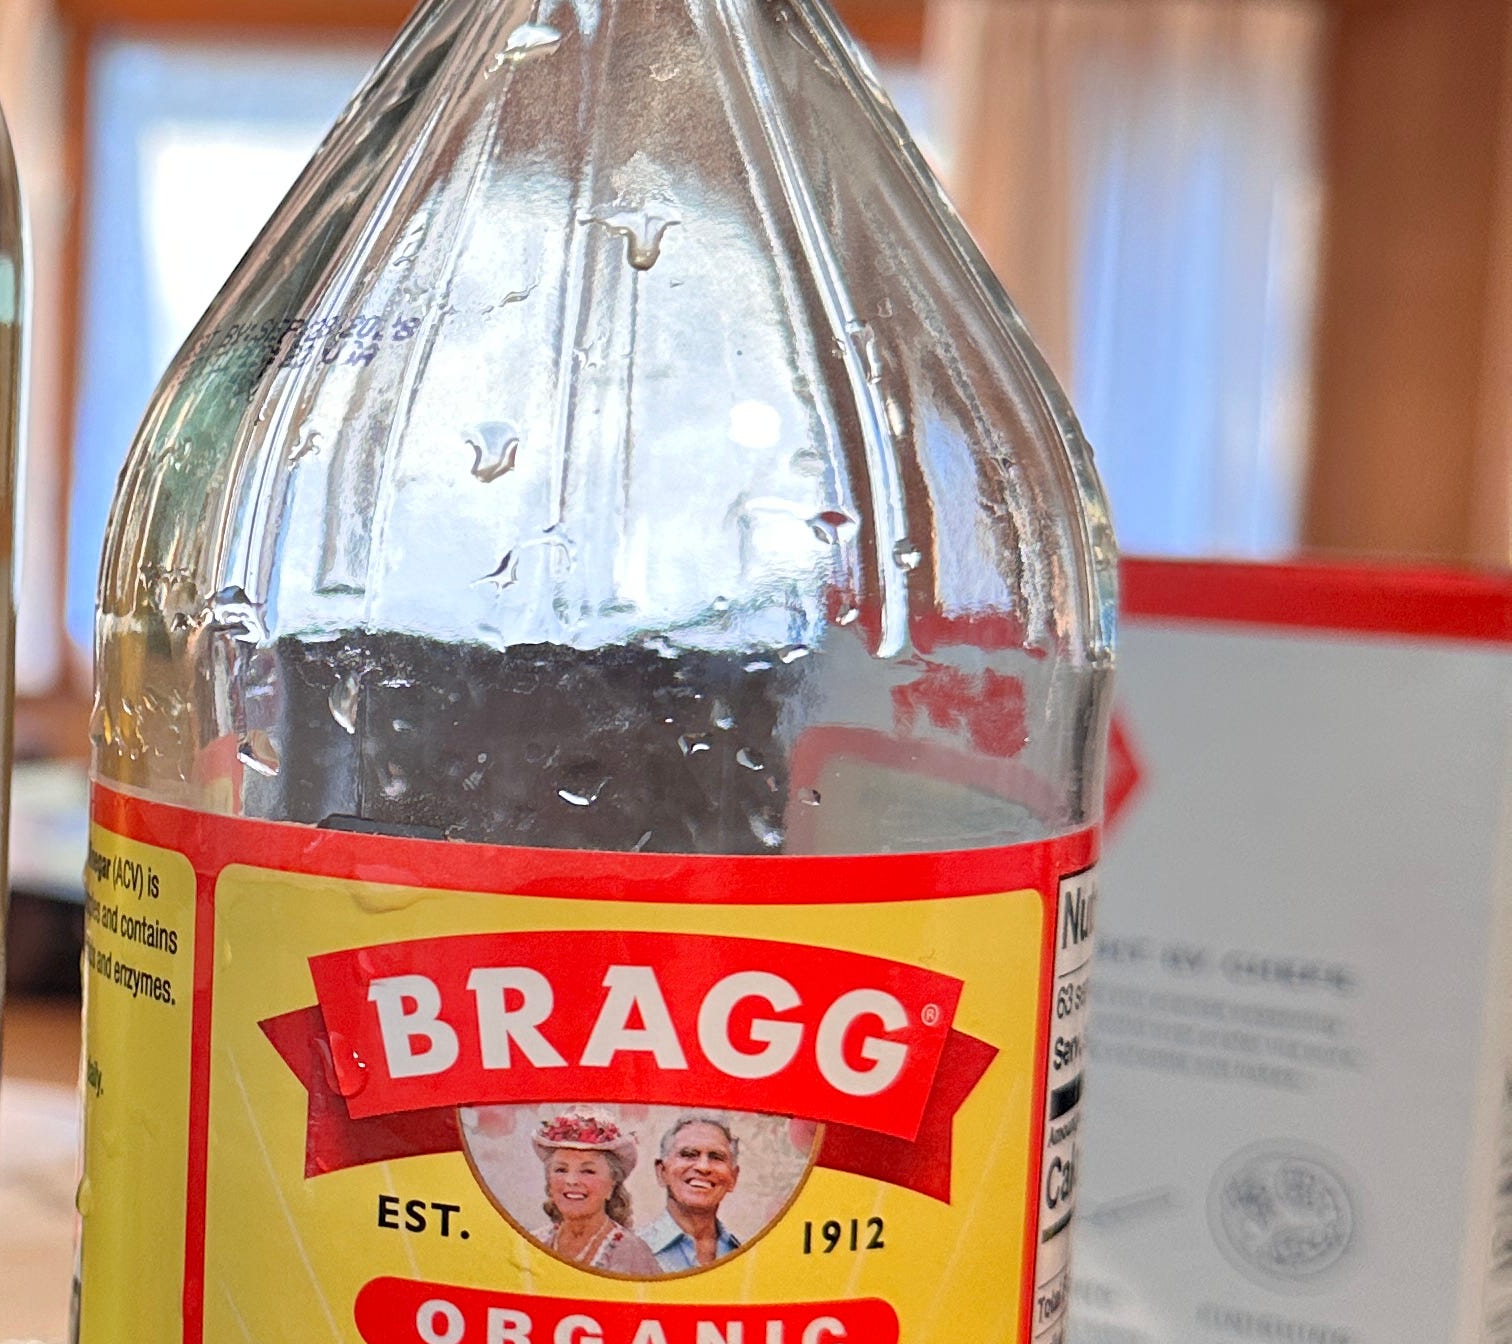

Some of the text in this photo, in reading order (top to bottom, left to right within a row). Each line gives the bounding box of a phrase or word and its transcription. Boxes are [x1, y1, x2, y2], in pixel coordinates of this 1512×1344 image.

[113, 856, 143, 900] (ACV)
[148, 866, 159, 899] is
[102, 905, 119, 934] and
[120, 914, 178, 955] contains
[97, 952, 112, 980] and
[114, 960, 176, 1006] enzymes.
[377, 1195, 471, 1241] EST.
[802, 1217, 887, 1255] 1912
